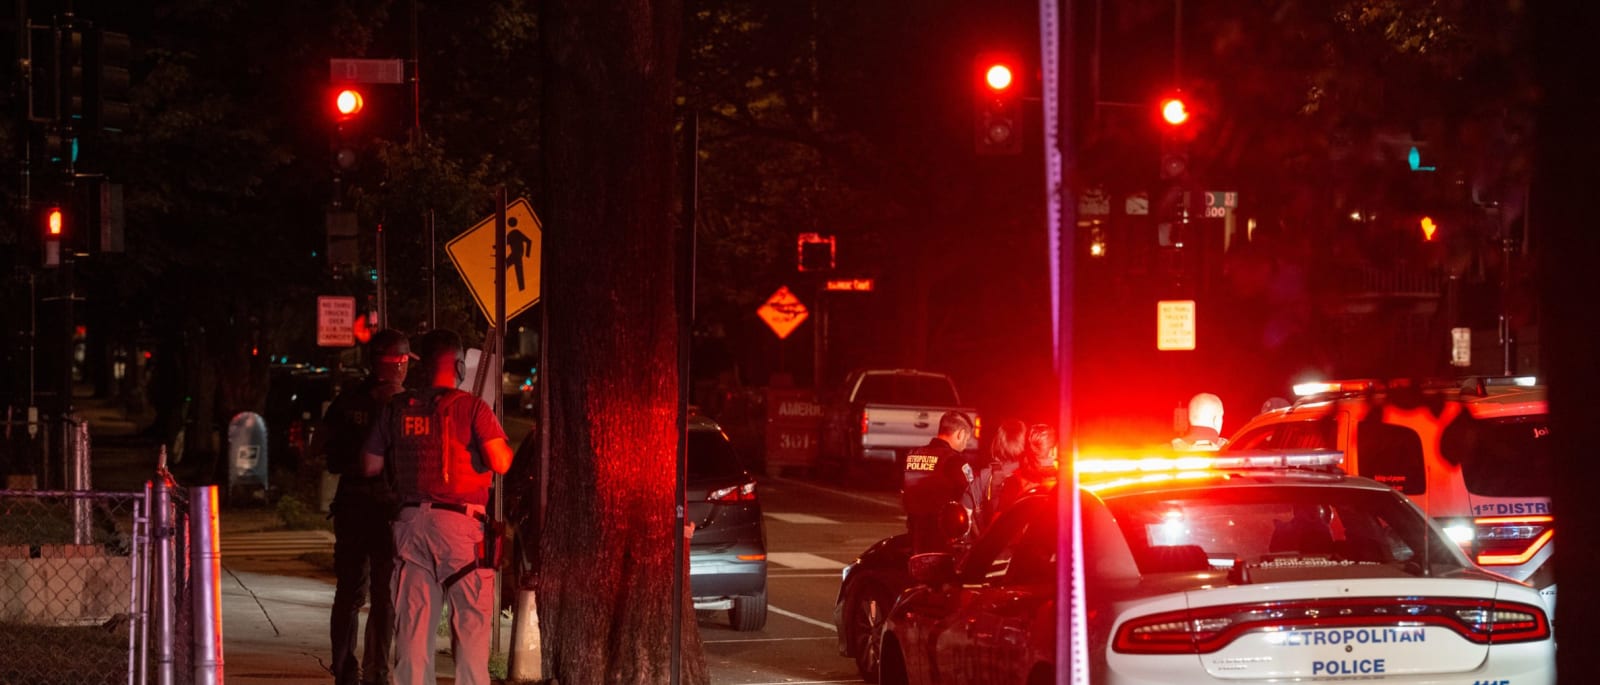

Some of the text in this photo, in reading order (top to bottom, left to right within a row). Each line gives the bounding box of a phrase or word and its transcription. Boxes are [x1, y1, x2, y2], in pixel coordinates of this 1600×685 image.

[405, 416, 430, 436] FBI
[906, 462, 935, 470] POLICE
[1474, 504, 1495, 515] 1ST
[1272, 629, 1425, 646] ETROPOLITAN
[1312, 659, 1386, 675] POLICE
